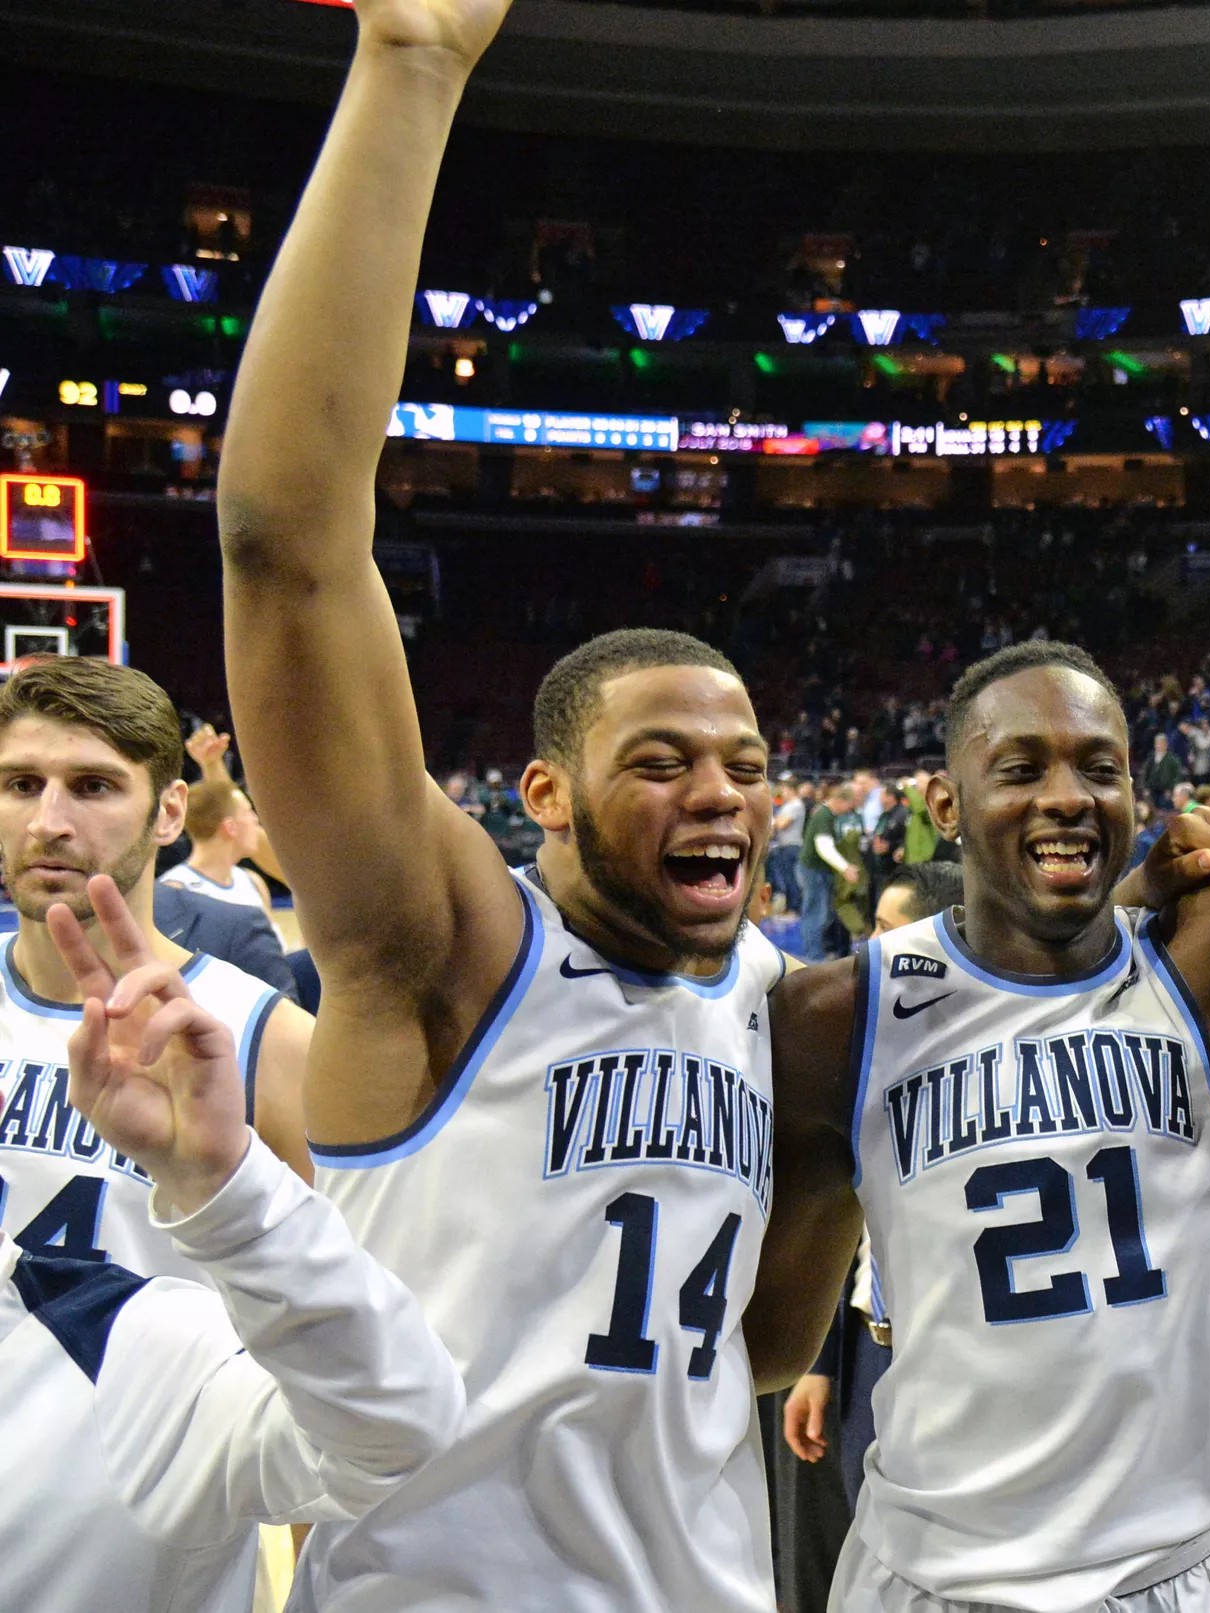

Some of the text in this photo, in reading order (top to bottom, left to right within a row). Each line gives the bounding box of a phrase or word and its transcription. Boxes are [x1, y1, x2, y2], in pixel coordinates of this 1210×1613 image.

[3, 245, 56, 286] V
[629, 303, 675, 340] V
[898, 957, 938, 973] RVM
[883, 1028, 1199, 1185] VILLANOVA
[0, 1173, 112, 1264] 4
[964, 1145, 1168, 1326] 21
[584, 1192, 742, 1381] 14
